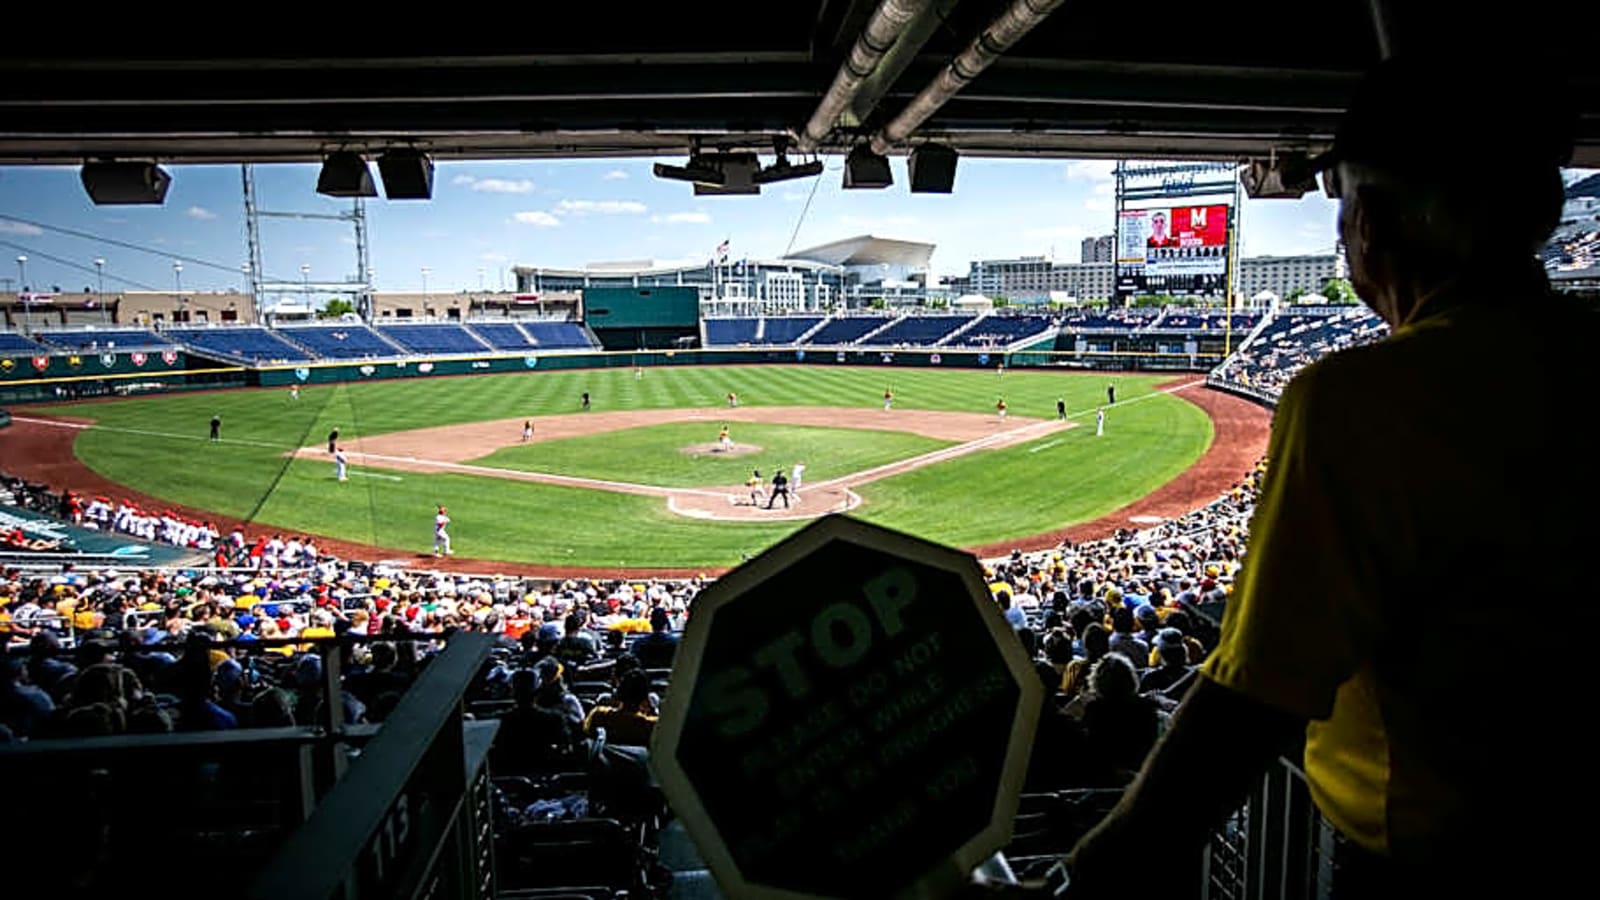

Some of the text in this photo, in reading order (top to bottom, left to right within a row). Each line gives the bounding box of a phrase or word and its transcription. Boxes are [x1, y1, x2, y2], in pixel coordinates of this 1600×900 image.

[1190, 207, 1208, 227] M
[699, 566, 919, 739] STOP
[848, 671, 889, 709] DO
[891, 632, 943, 677] NOT
[371, 792, 411, 881] 113
